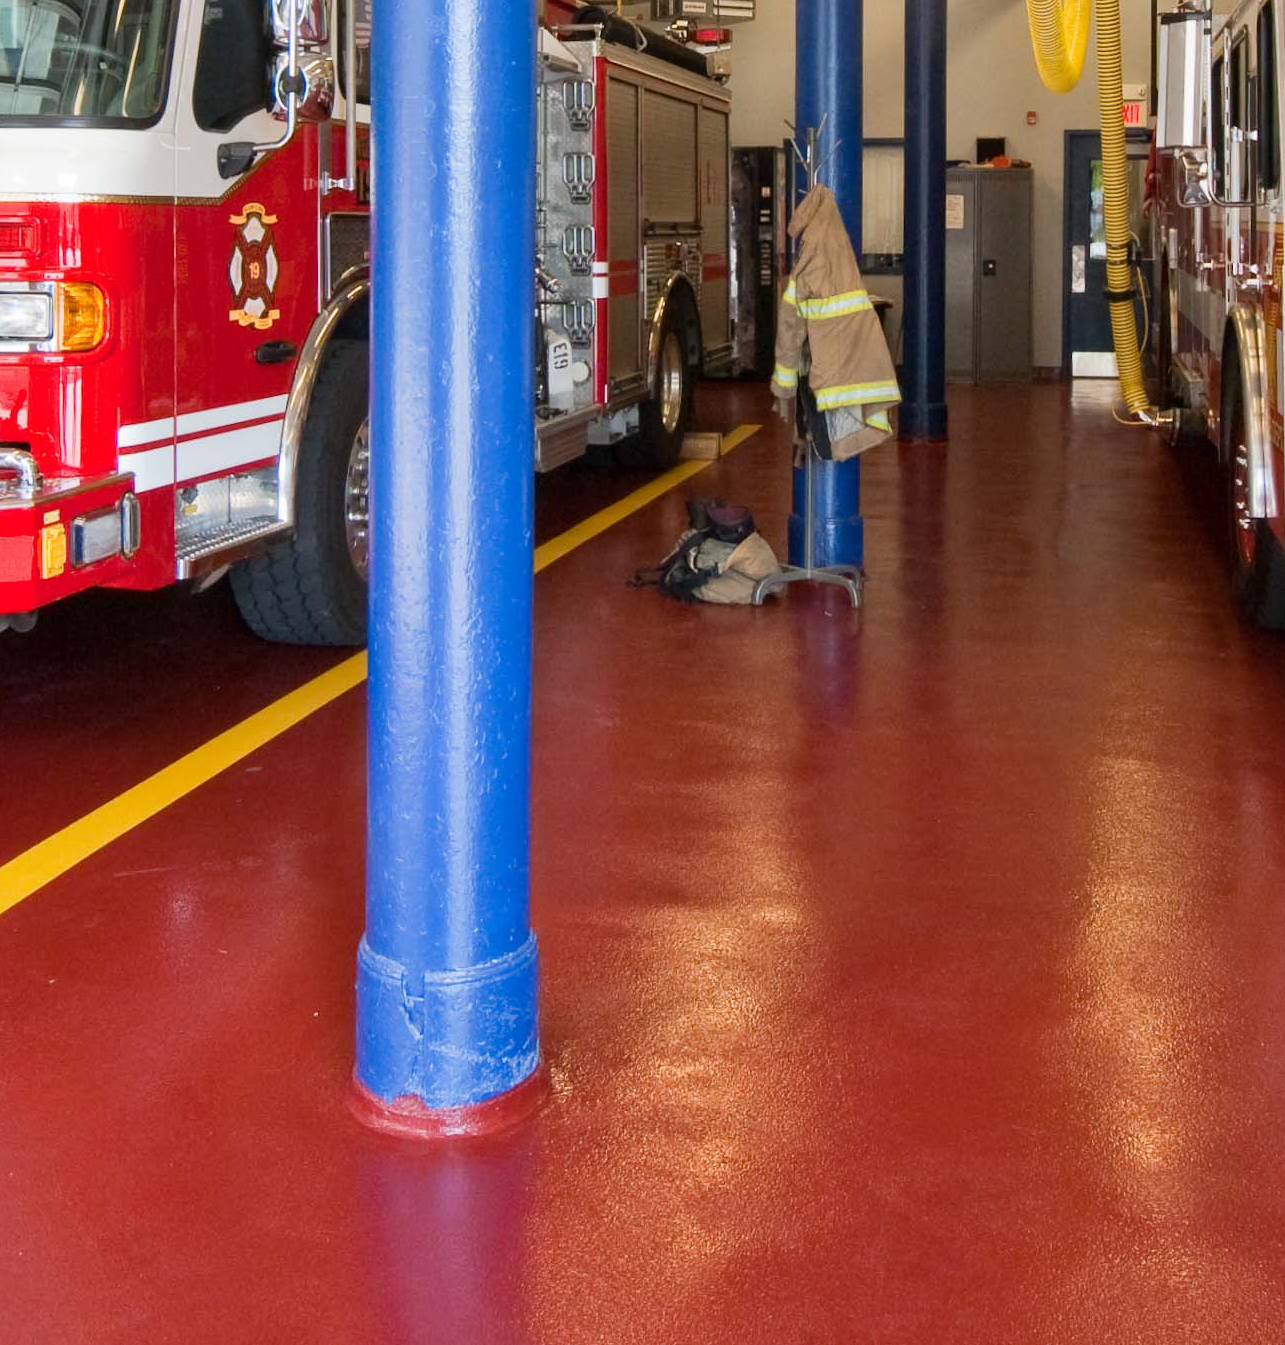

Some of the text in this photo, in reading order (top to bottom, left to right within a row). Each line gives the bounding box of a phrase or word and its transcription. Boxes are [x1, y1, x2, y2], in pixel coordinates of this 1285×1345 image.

[1122, 103, 1141, 124] XIT
[249, 261, 260, 279] 19
[553, 342, 569, 370] E19
